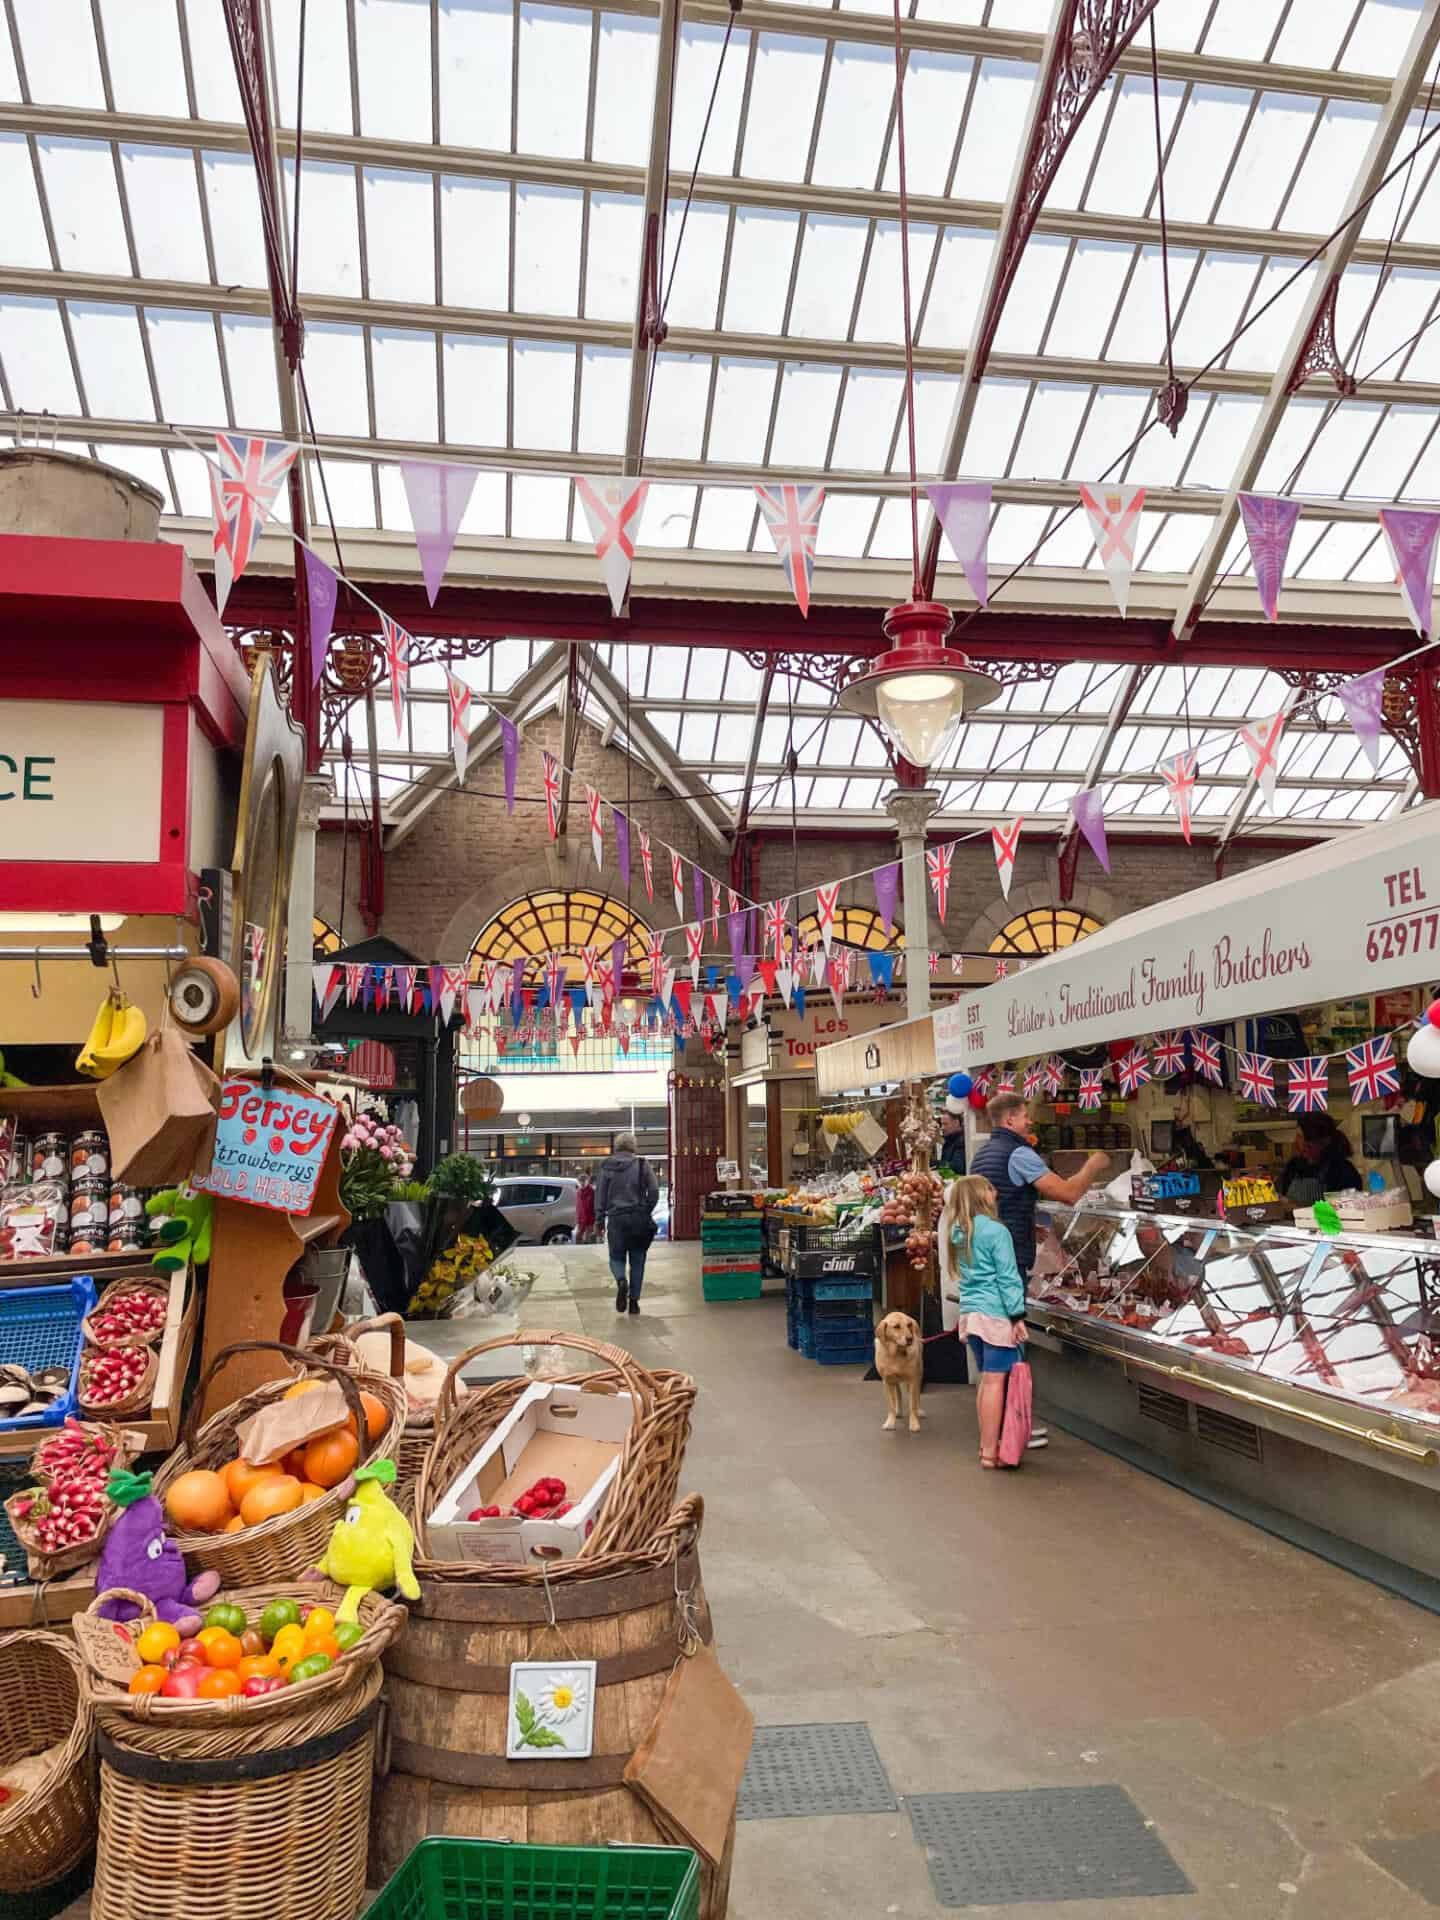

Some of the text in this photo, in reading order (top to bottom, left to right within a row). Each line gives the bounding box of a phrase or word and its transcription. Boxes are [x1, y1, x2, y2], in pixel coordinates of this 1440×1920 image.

[1383, 867, 1426, 907] TEL
[1366, 914, 1440, 963] 62977
[1059, 967, 1136, 1025] Traditional
[1141, 949, 1206, 1016] Family
[1214, 928, 1312, 990] Butchers
[814, 1016, 849, 1034] Les
[967, 1003, 981, 1025] EST
[218, 1084, 331, 1156] Jersey
[254, 1174, 309, 1207] HERE
